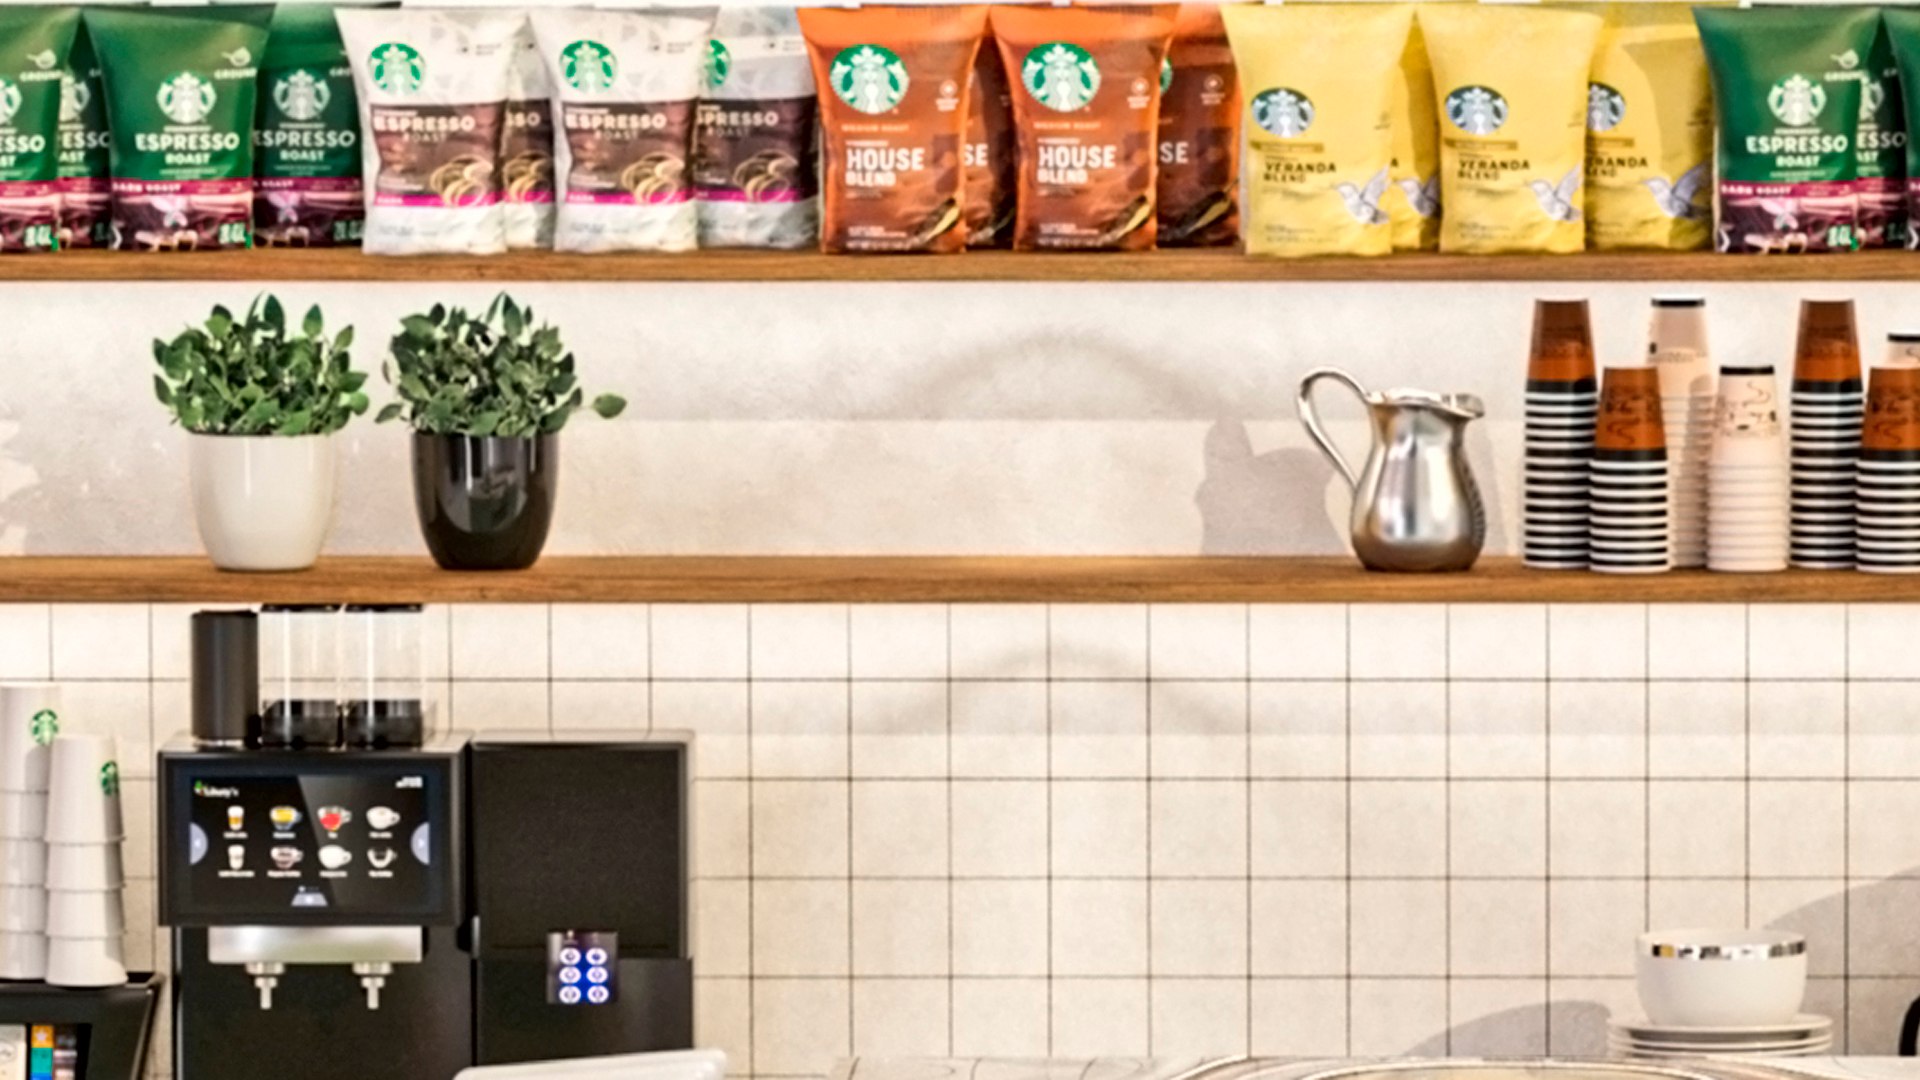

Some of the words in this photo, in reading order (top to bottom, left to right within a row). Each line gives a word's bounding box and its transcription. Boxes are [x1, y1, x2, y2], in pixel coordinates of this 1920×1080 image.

[373, 116, 475, 131] ESPRESSO
[565, 113, 667, 129] ESPRESSO
[135, 132, 240, 151] ESPRESSO
[1746, 134, 1849, 153] ESPRESSO
[165, 152, 211, 165] ROAST
[279, 149, 325, 162] ROAST
[846, 148, 926, 171] HOUSE
[1038, 145, 1117, 169] HOUSE
[1160, 142, 1189, 164] SE
[1265, 162, 1337, 173] VERANDA
[1459, 159, 1531, 170] VERANDA
[1776, 154, 1821, 168] ROAST
[845, 171, 897, 187] BLEND
[1037, 168, 1089, 184] BLEND
[1263, 173, 1307, 183] BLEND
[1457, 170, 1500, 181] BLEND
